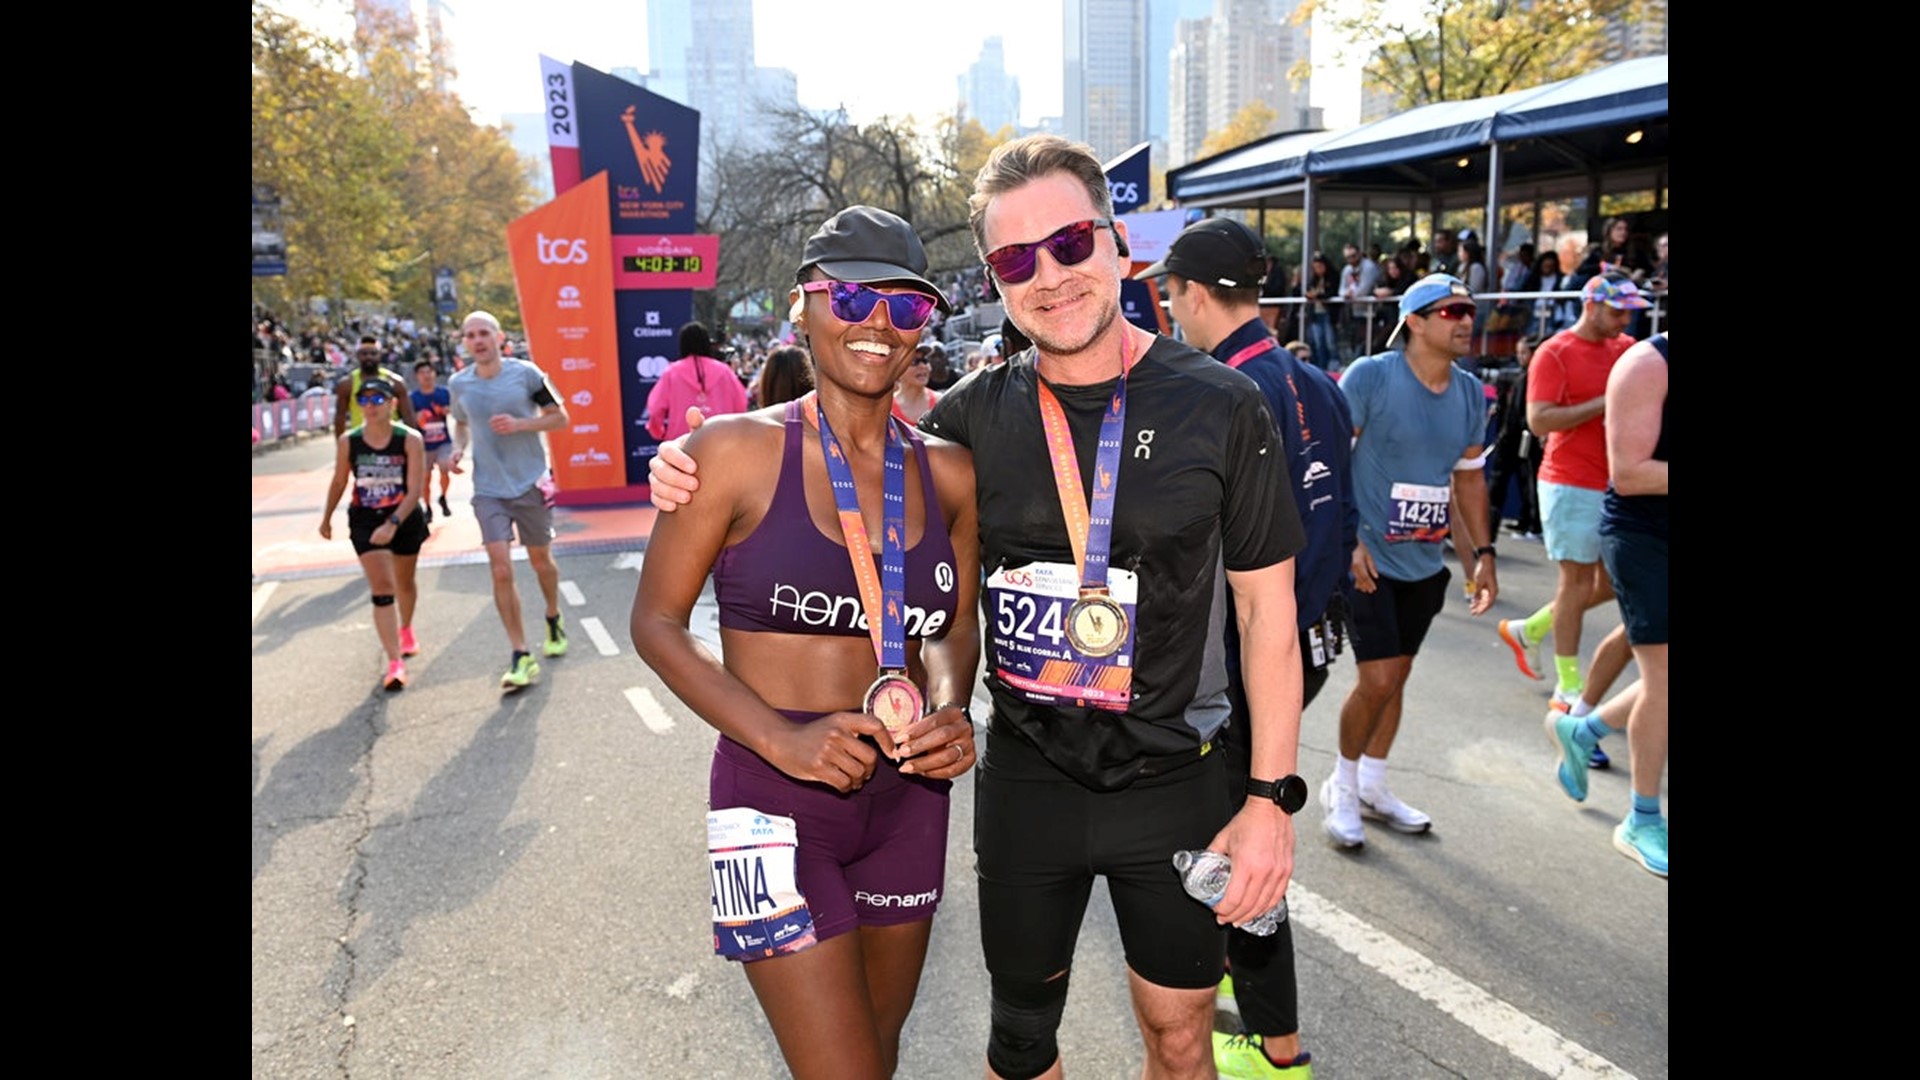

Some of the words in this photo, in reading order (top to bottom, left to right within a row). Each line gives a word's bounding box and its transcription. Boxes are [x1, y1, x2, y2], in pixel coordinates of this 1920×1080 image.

[548, 73, 571, 135] 2023
[617, 185, 640, 199] tcs
[536, 232, 589, 264] tcs
[633, 327, 672, 337] Citizens
[1099, 440, 1119, 448] 2023
[1397, 501, 1448, 524] 14215
[1090, 518, 1110, 526] 2023
[997, 591, 1065, 646] 524
[1008, 639, 1015, 651] 5
[1016, 643, 1032, 655] BLUE
[1032, 647, 1061, 658] CORRAL
[1062, 649, 1072, 660] A
[1082, 688, 1105, 698] 2023
[750, 828, 774, 836] TATA
